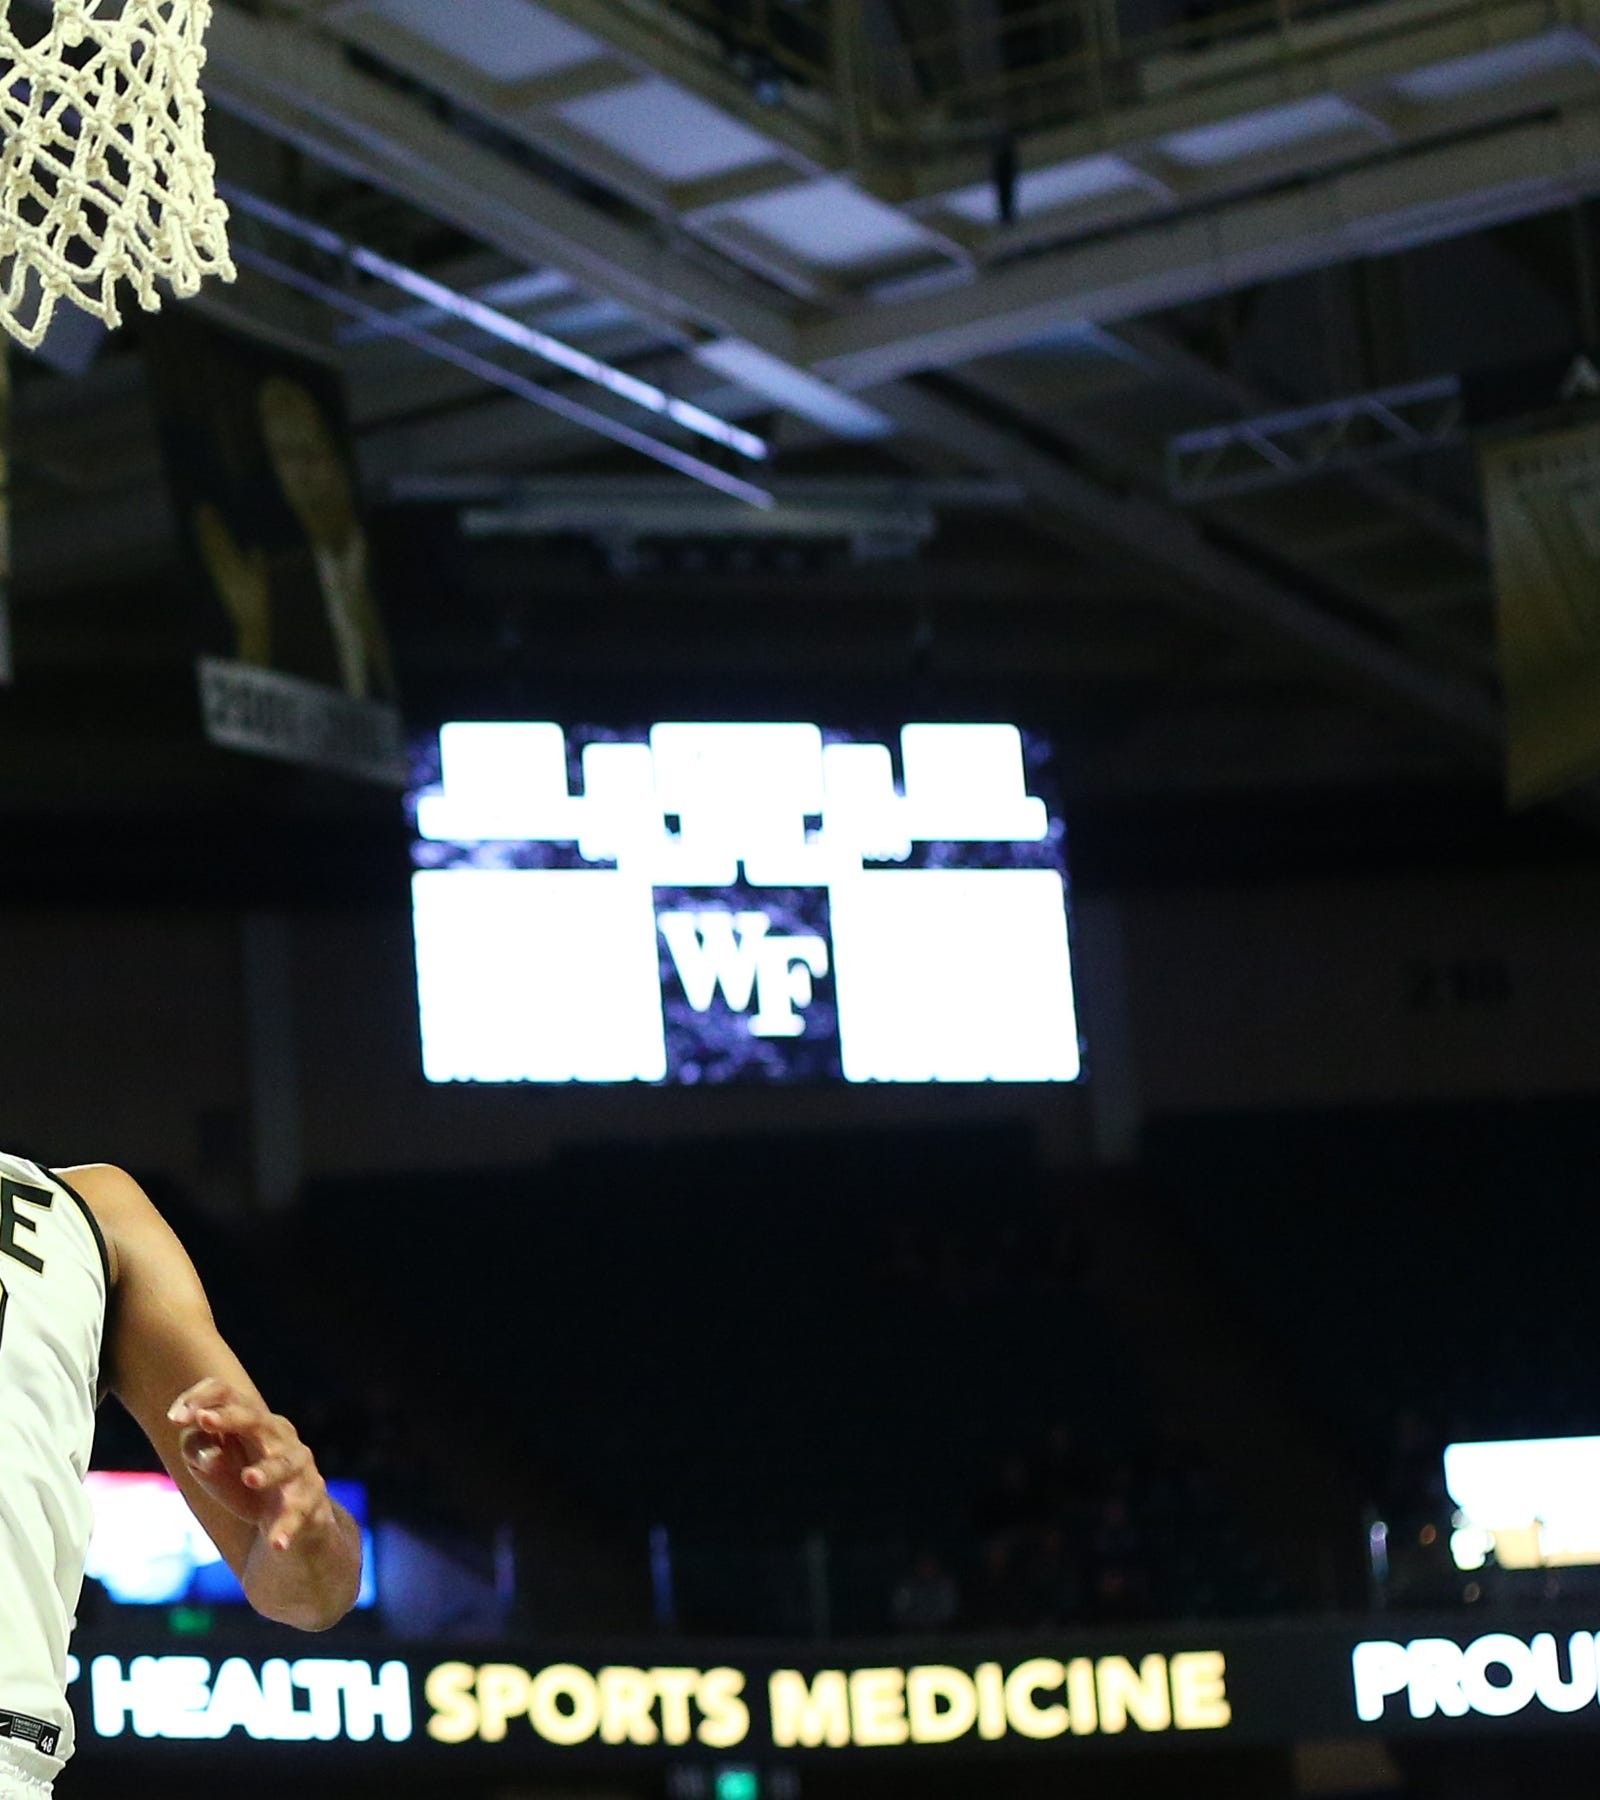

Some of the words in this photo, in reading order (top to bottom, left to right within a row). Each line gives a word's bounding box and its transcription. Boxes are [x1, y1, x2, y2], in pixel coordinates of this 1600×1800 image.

[657, 910, 828, 1037] WF
[90, 1655, 412, 1742] HEALTH
[425, 1661, 750, 1747] SPORTS
[768, 1651, 1231, 1748] MEDICINE
[1352, 1630, 1600, 1722] PROU
[40, 1735, 54, 1753] 48
